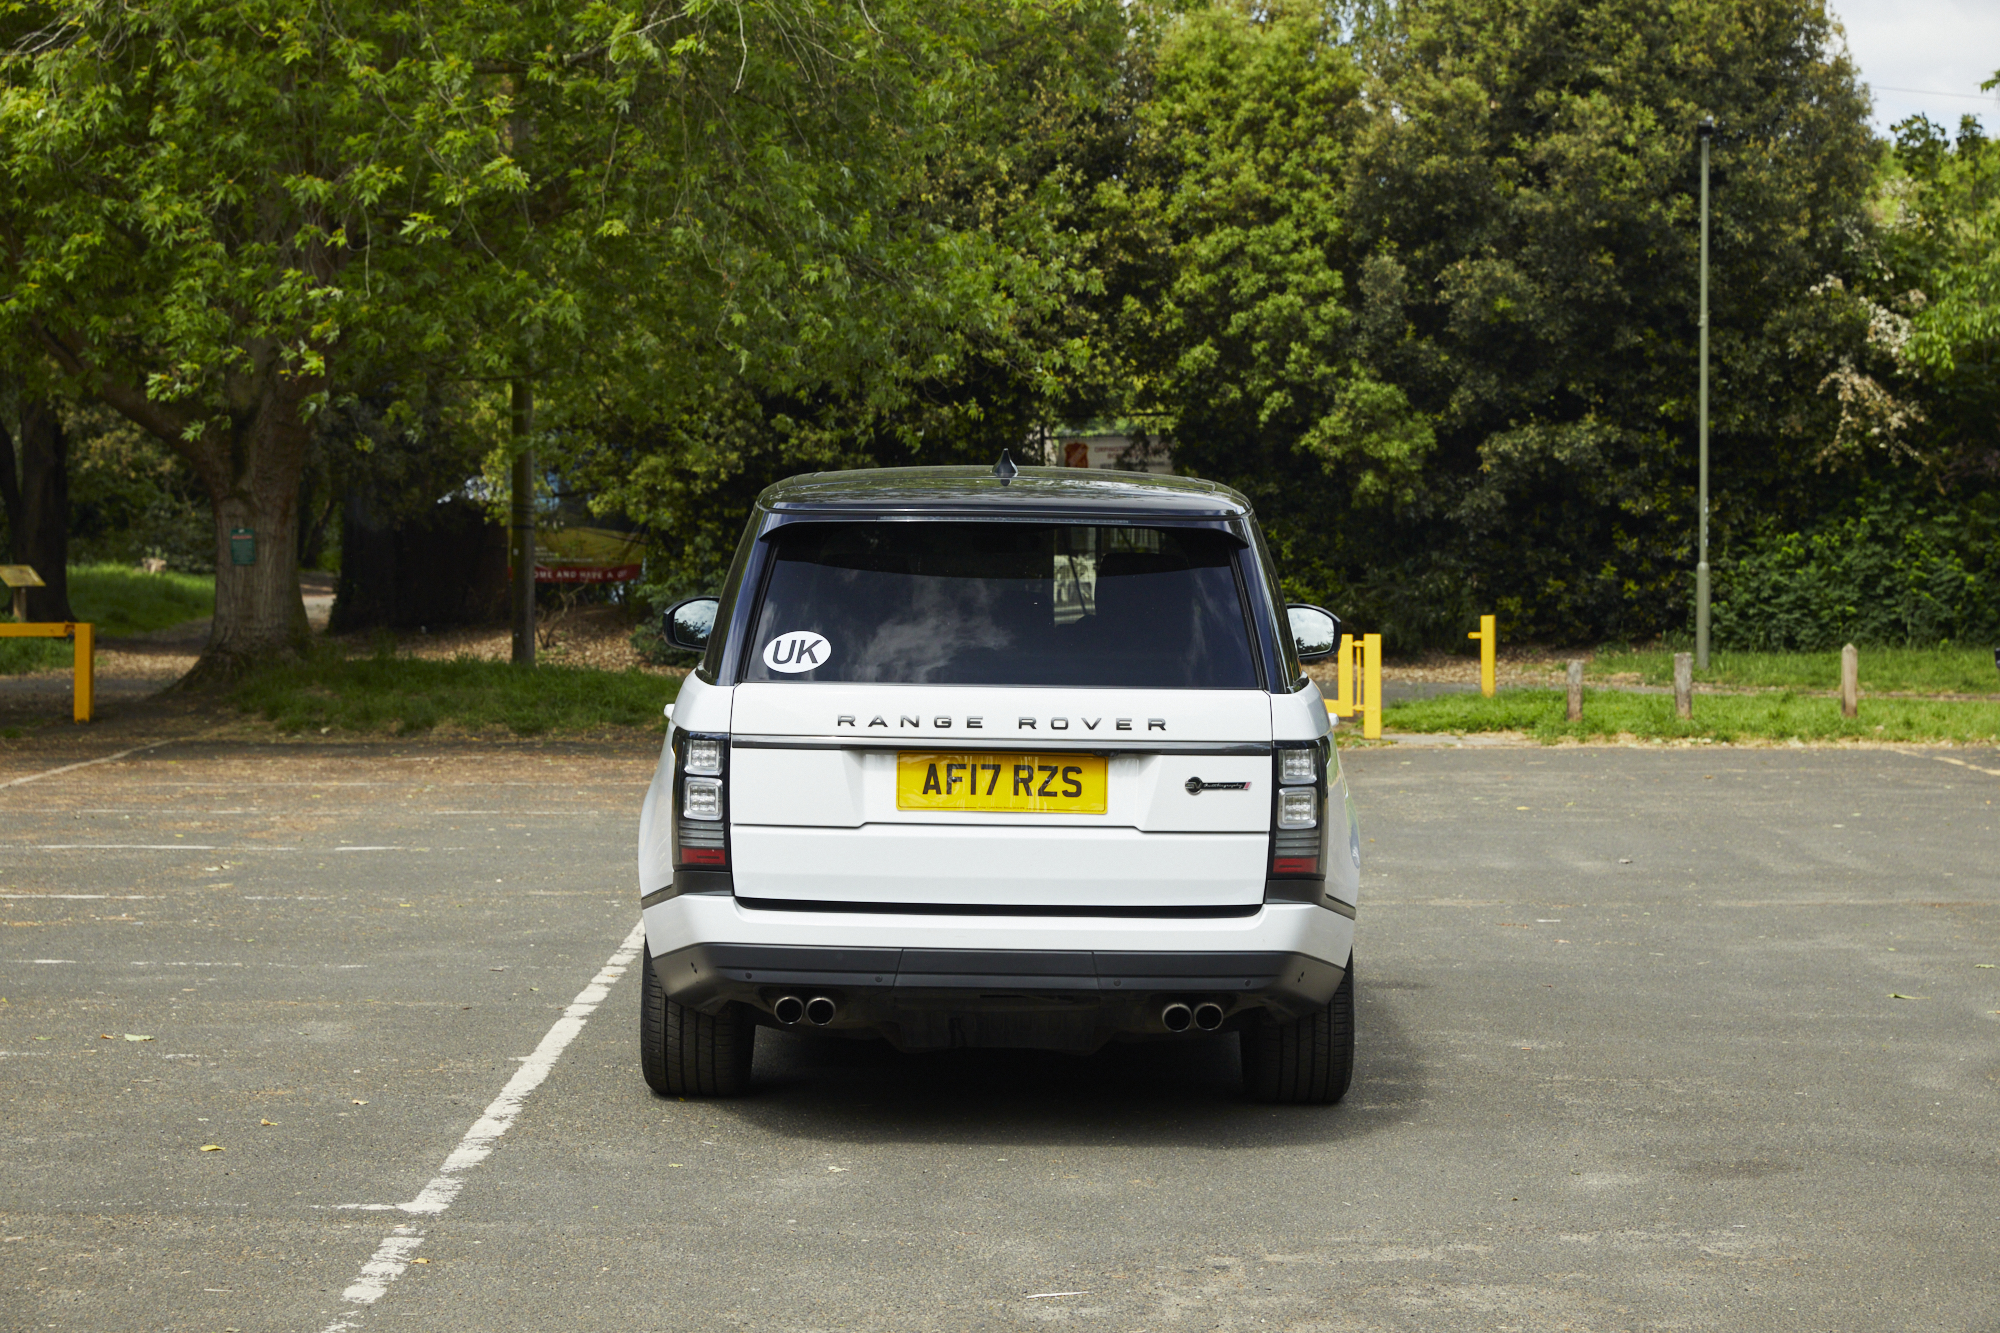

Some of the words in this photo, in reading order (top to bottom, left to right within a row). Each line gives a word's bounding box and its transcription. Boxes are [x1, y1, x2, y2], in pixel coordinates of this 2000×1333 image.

[533, 570, 552, 579] OME
[556, 570, 577, 579] AND
[579, 570, 603, 580] HAVE
[606, 570, 615, 579] A
[772, 639, 823, 665] UK
[837, 714, 984, 729] RANGE
[1018, 716, 1167, 731] ROVER
[922, 763, 1001, 796] AF17
[1013, 764, 1083, 798] RZS
